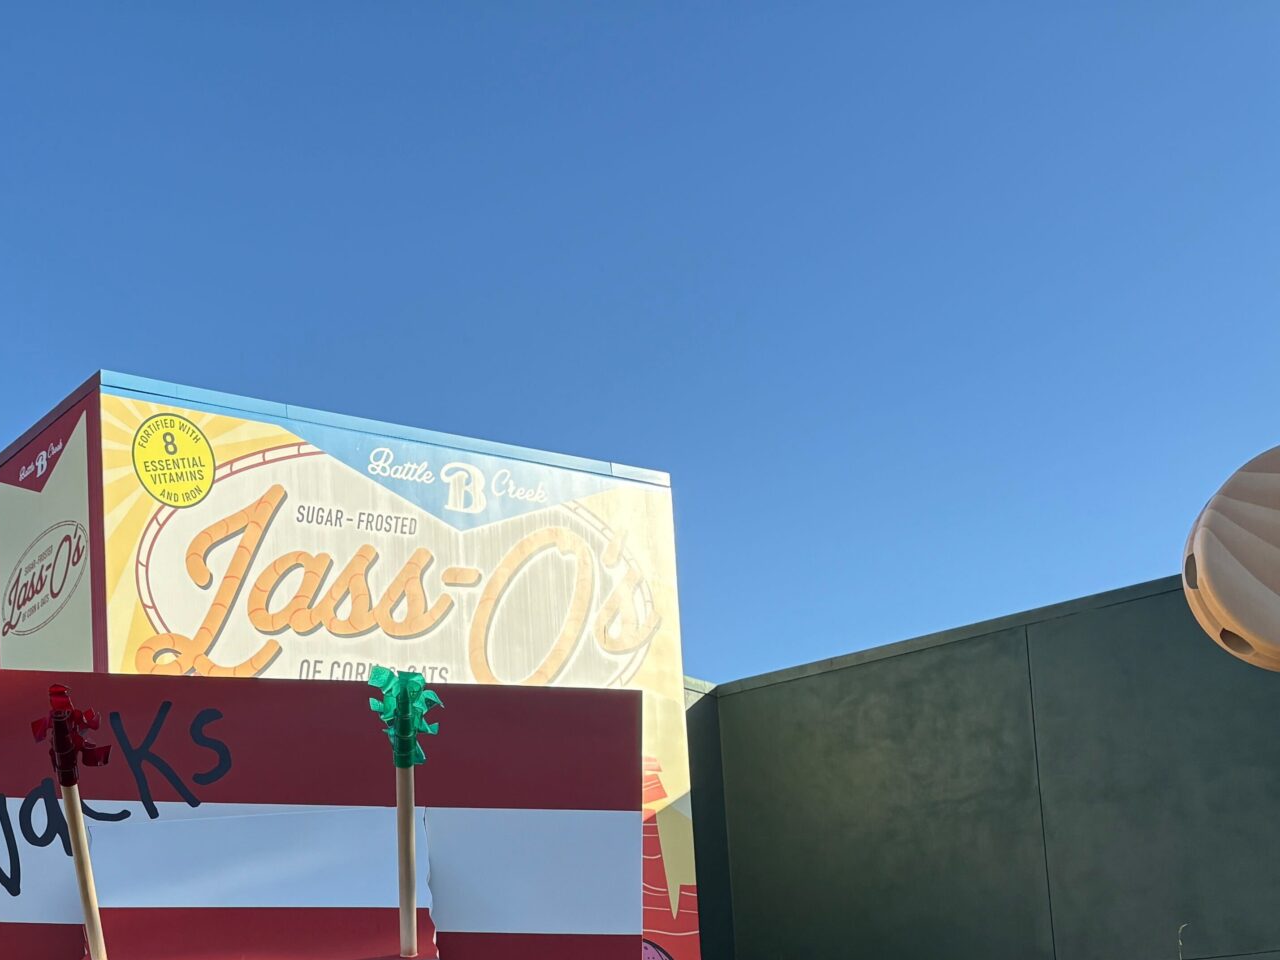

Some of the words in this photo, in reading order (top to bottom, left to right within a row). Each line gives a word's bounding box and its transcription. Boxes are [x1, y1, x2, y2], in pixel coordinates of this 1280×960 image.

[138, 419, 174, 448] FORTIFIED
[179, 421, 201, 443] WITH
[163, 432, 177, 455] 8
[144, 456, 205, 472] ESSENTIAL
[368, 448, 435, 484] Battle
[491, 469, 548, 502] Creek
[151, 470, 204, 484] VITAMINS
[160, 489, 178, 502] AND
[182, 485, 202, 502] IRON
[299, 659, 323, 680] OF
[330, 661, 372, 681] COR
